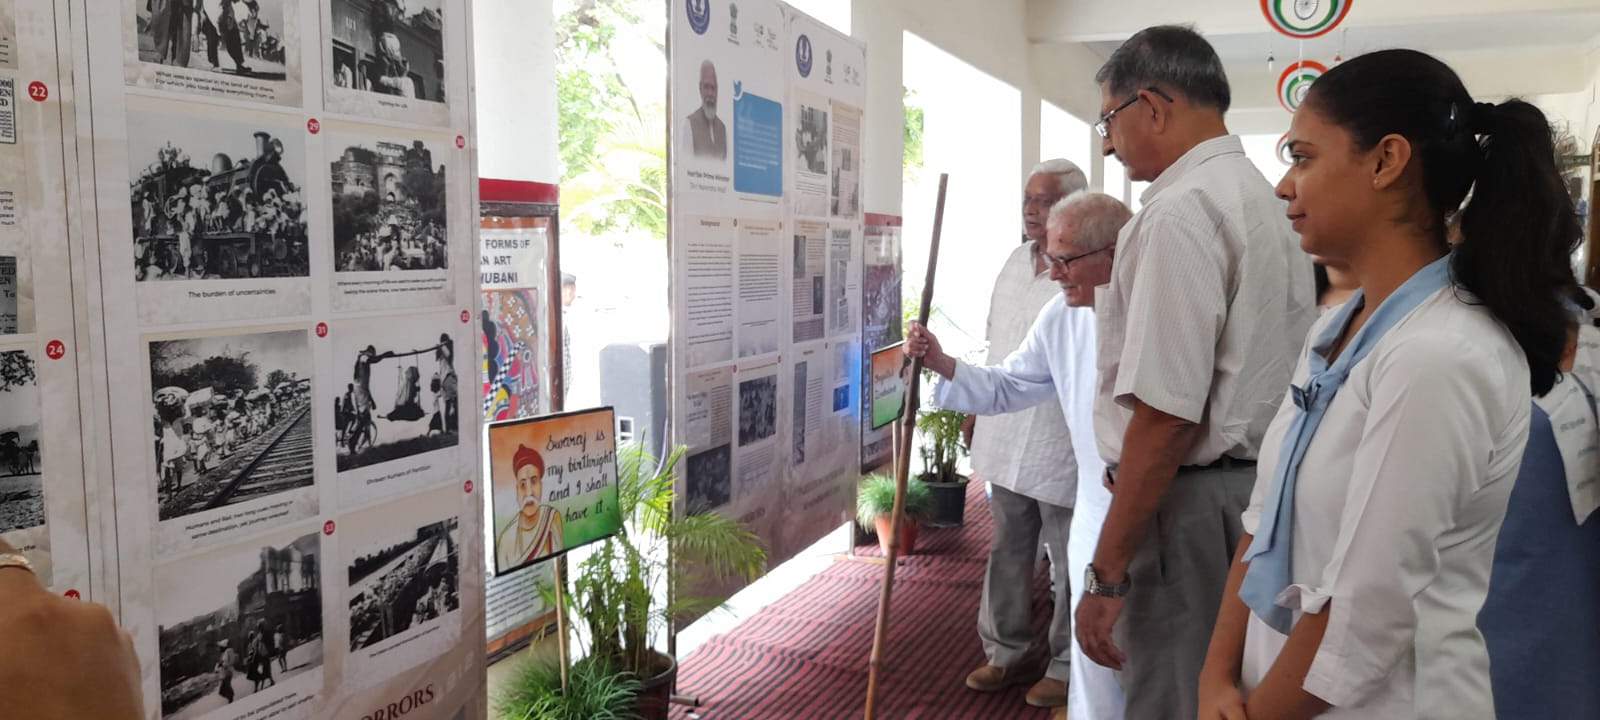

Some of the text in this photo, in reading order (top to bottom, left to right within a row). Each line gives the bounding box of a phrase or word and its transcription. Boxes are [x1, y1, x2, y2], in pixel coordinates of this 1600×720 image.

[31, 86, 46, 97] 22
[485, 239, 531, 249] FORMS OF
[494, 255, 512, 265] ART
[202, 290, 227, 298] burden
[235, 288, 276, 296] uncertainties
[48, 345, 63, 355] 24
[546, 429, 605, 453] Swaraj is
[547, 449, 613, 484] my birthright
[548, 482, 570, 502] and
[585, 473, 608, 493] shall
[565, 507, 588, 523] have
